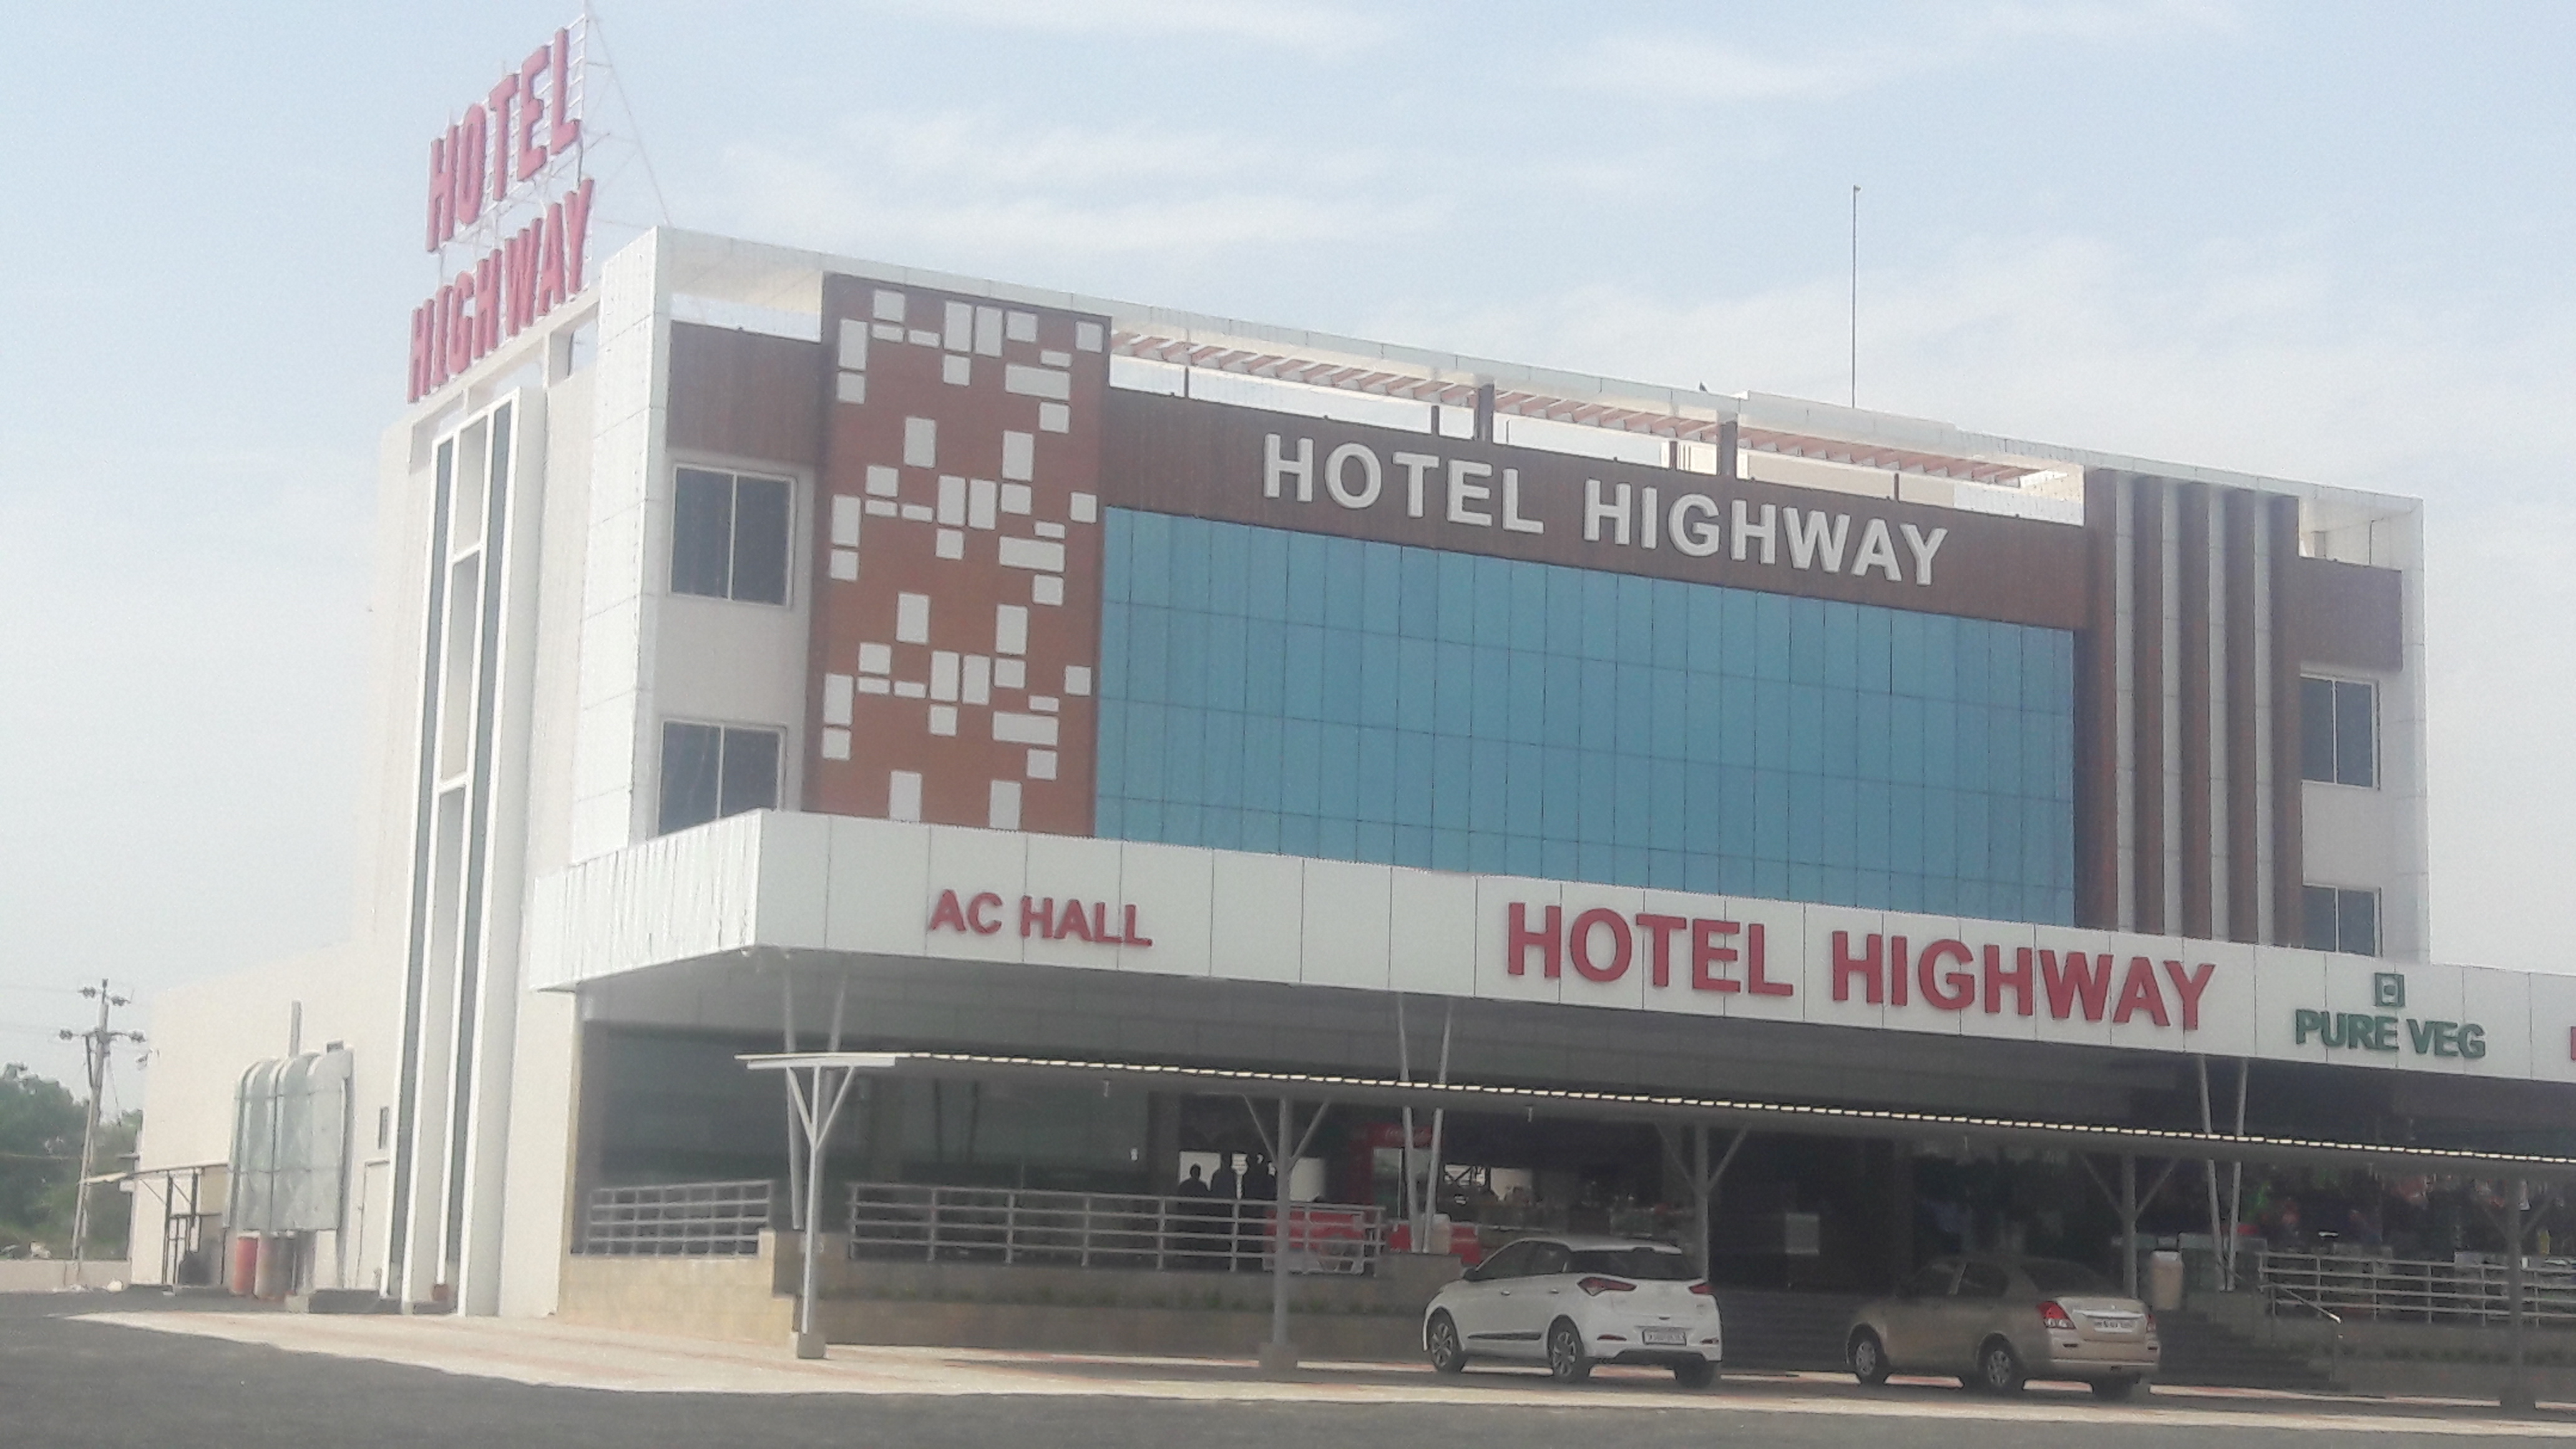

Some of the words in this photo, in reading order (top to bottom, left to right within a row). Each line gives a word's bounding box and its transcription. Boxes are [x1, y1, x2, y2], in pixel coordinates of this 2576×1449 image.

[426, 27, 582, 253] HOTEL
[407, 177, 595, 404] HIGHWAY
[1262, 433, 1544, 535] HOTEL
[1583, 477, 1948, 586] HIGHWAY
[929, 889, 1003, 934] AC
[1020, 895, 1153, 947] HALL
[1507, 902, 1794, 997] HOTEL
[1832, 930, 2215, 1031] HIGHWAY
[2295, 1008, 2399, 1050] PURE
[2406, 1018, 2486, 1059] VEG
